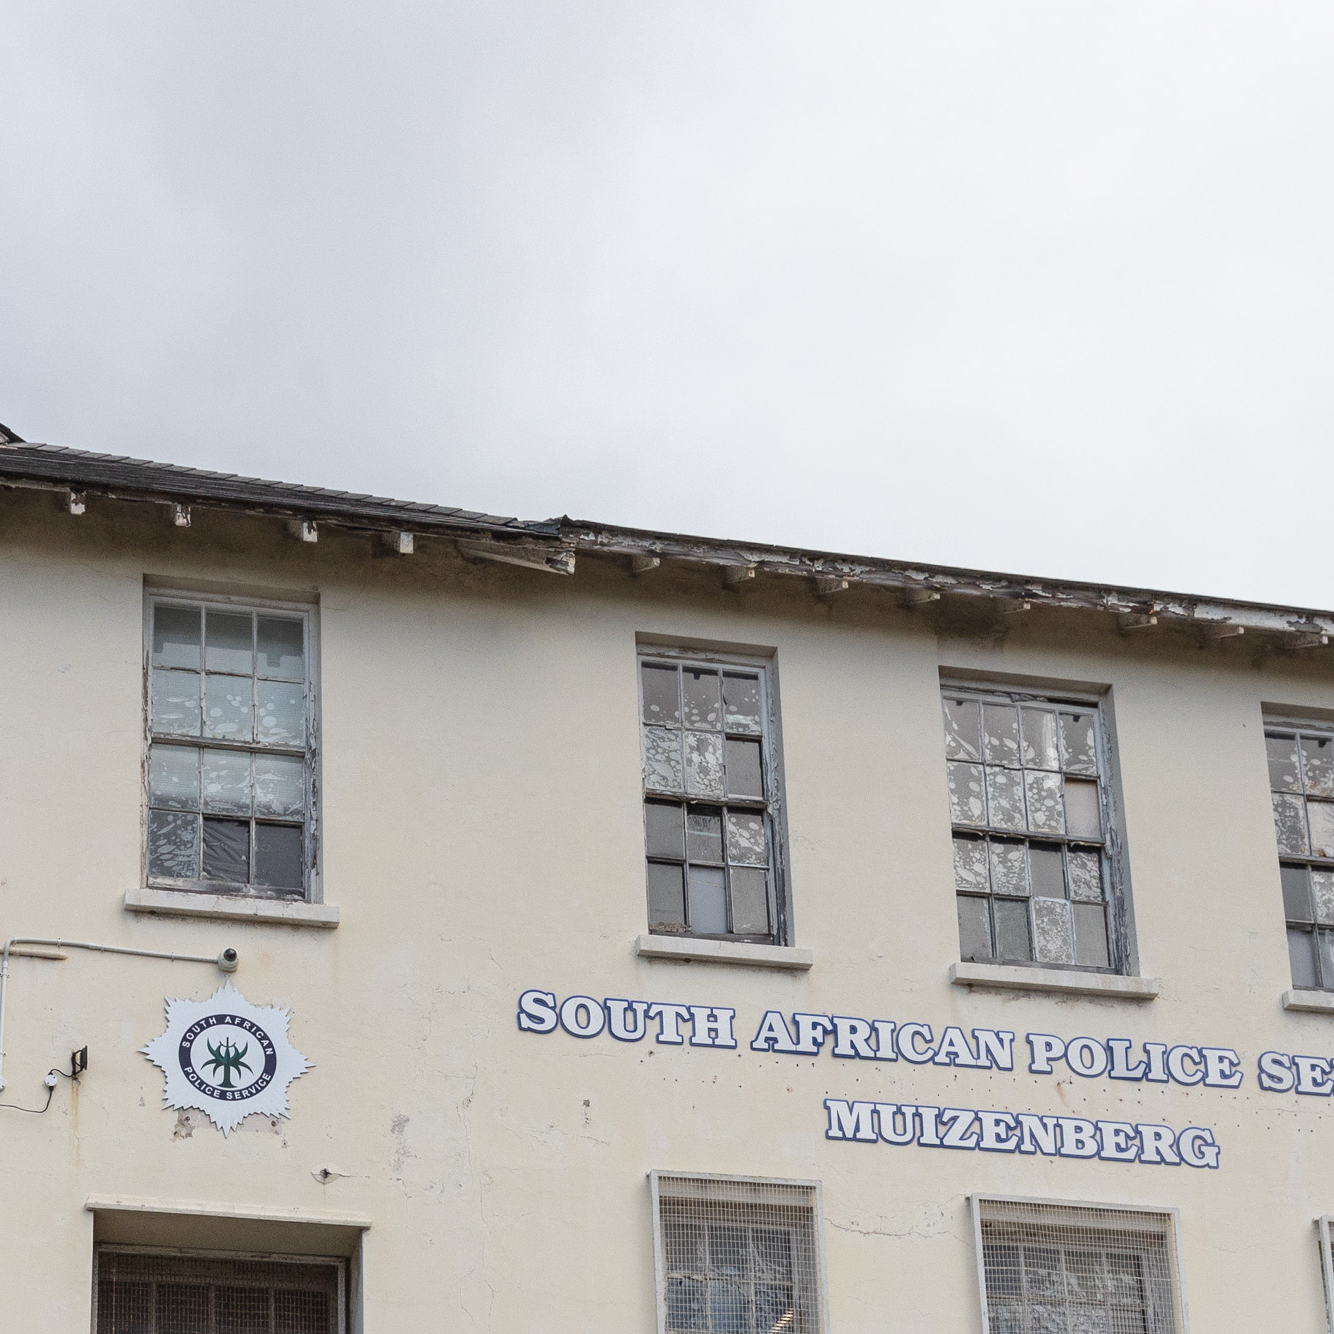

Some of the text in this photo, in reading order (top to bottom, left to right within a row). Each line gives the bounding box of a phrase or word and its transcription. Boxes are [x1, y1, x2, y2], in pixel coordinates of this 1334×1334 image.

[181, 1015, 274, 1056] SOUTH AFRICAN
[517, 989, 737, 1049] SOUTH
[751, 1010, 1015, 1071] AFRICAN
[1027, 1032, 1244, 1087] POLICE
[183, 1065, 272, 1100] POLICE SERVICE
[824, 1098, 1221, 1169] MUIZENBERG
